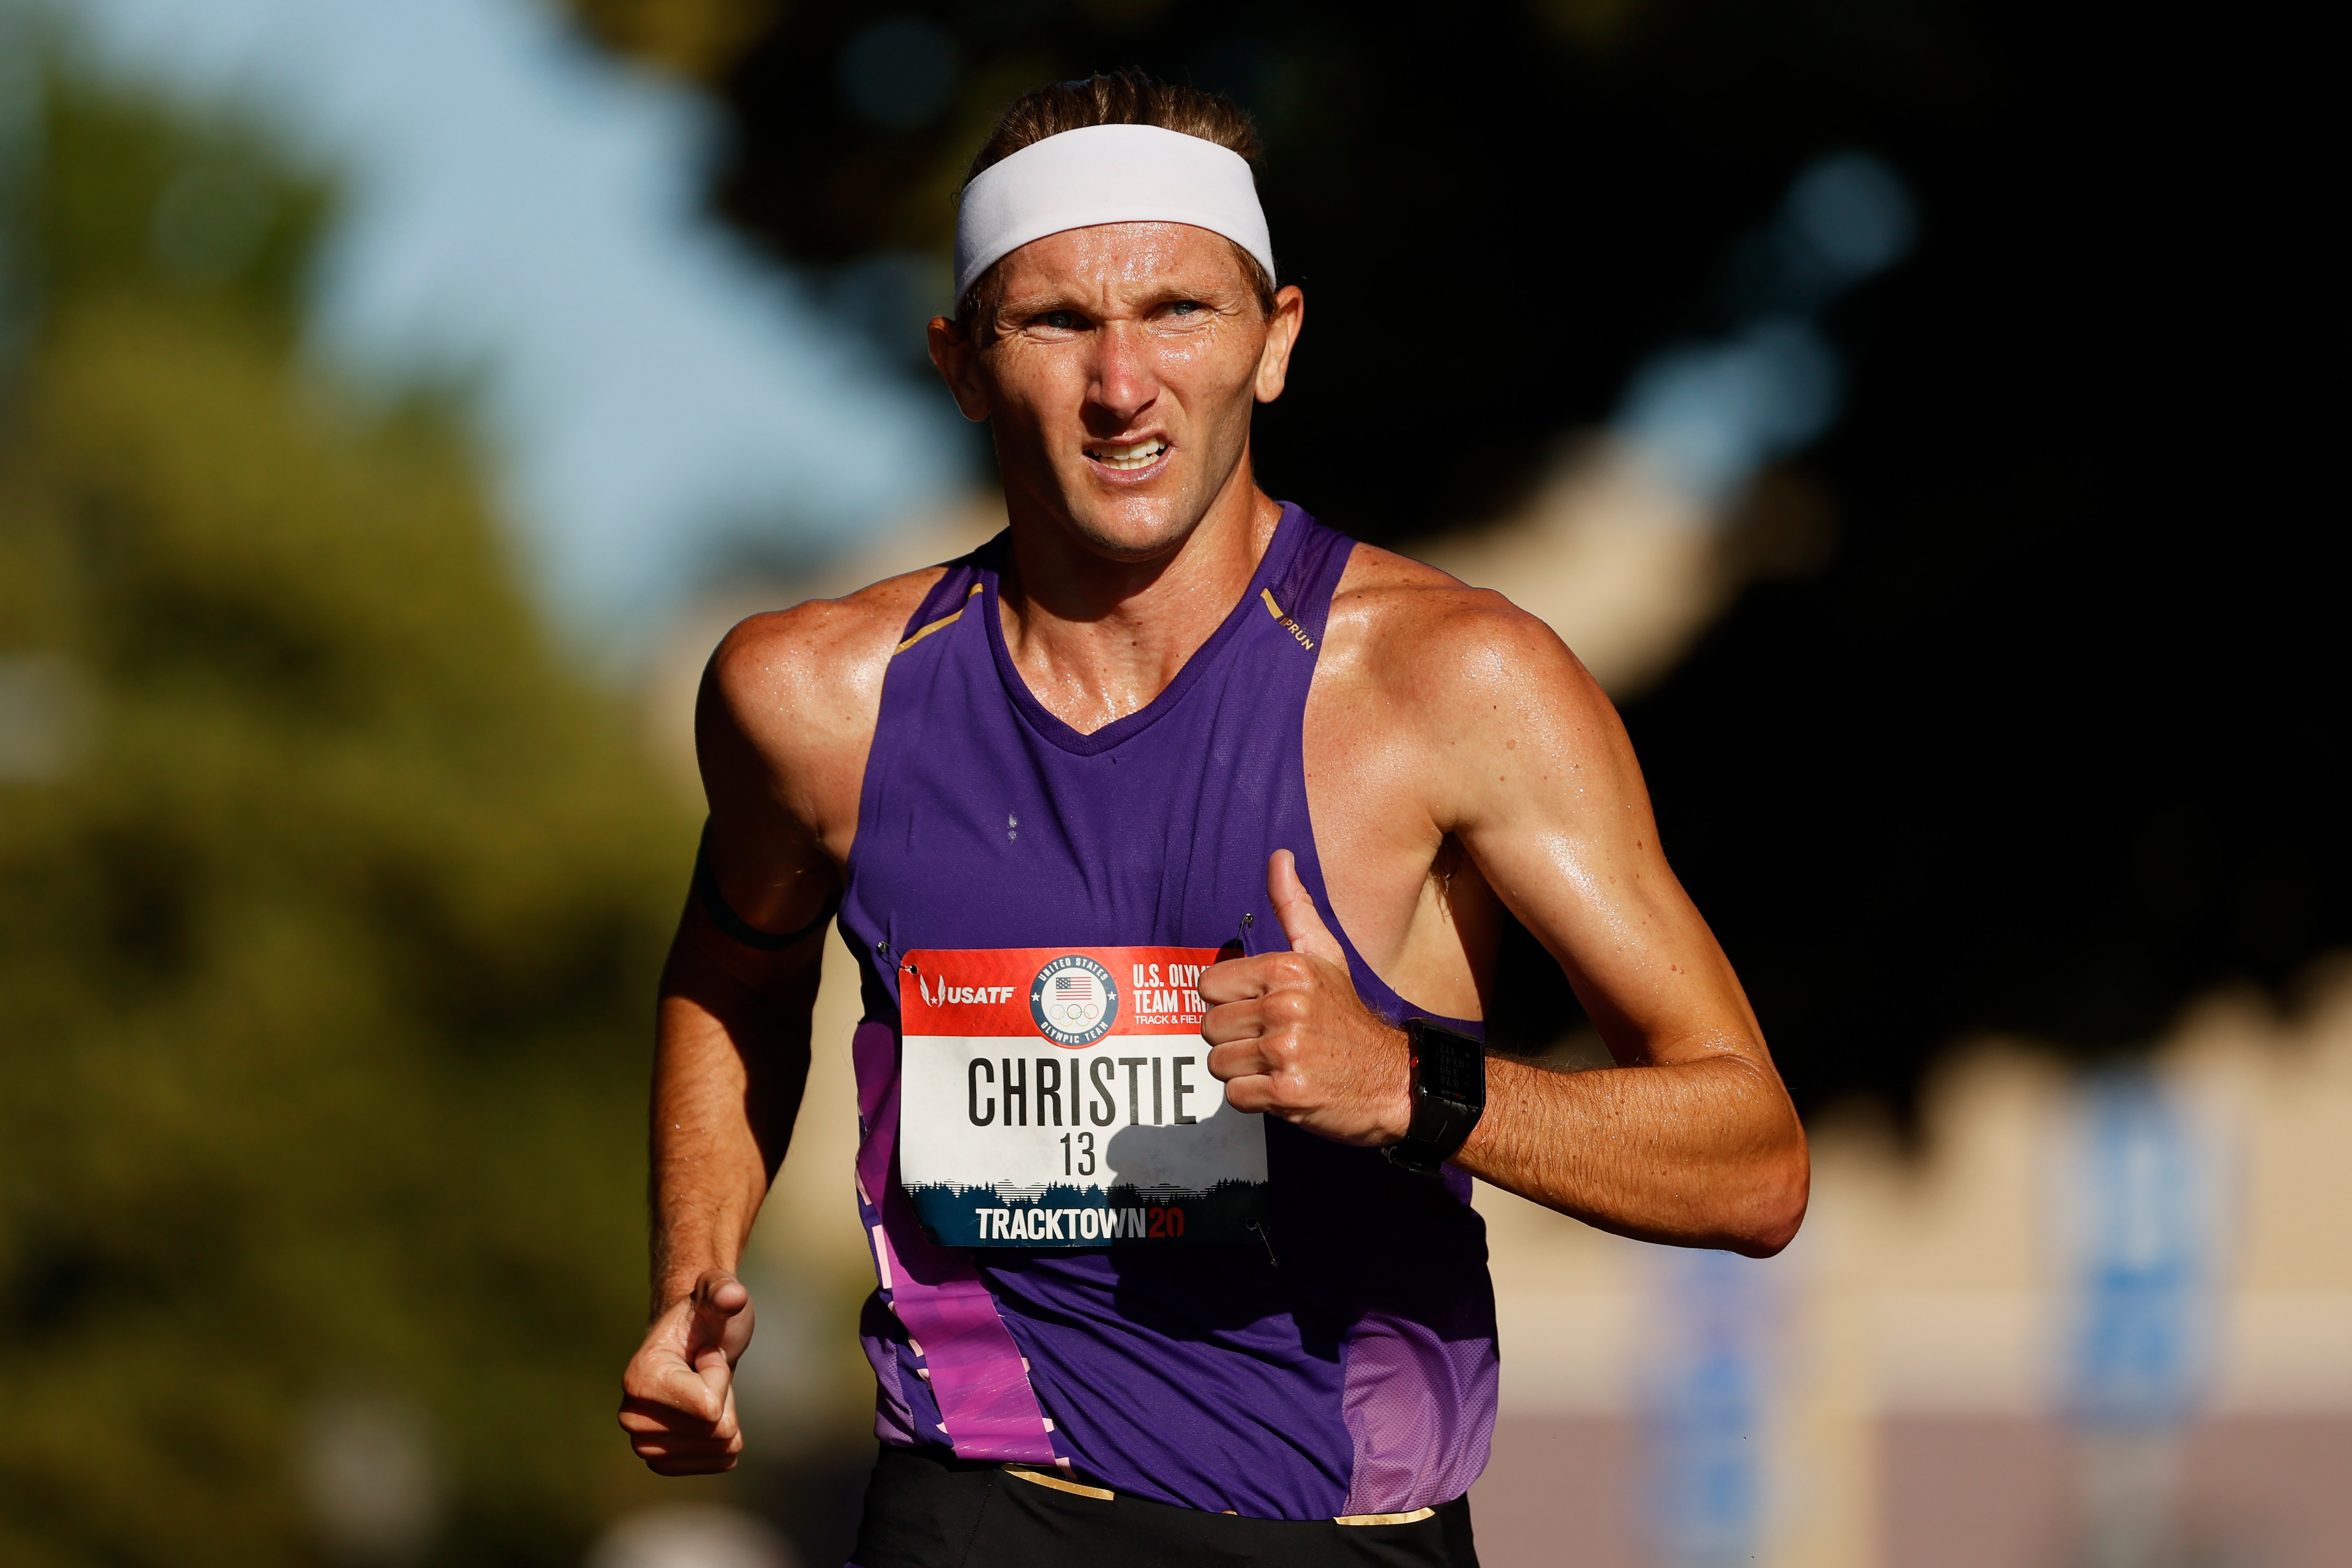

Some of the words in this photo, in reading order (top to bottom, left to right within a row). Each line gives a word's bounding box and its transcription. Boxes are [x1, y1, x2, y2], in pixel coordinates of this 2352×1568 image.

[1038, 958, 1071, 981] UNITED
[1075, 957, 1108, 981] STATES
[1133, 963, 1164, 988] U.S.
[1169, 963, 1211, 988] OLYM
[947, 987, 1014, 1004] USATF
[1133, 989, 1179, 1013] TEAM
[1182, 989, 1206, 1013] TRI
[1134, 1015, 1169, 1024] TRACK
[1171, 1015, 1178, 1024] &
[1041, 1021, 1080, 1044] OLYMPIC
[1084, 1021, 1109, 1041] TEAM
[968, 1056, 1197, 1127] CHRISTIE
[1060, 1132, 1095, 1176] 13
